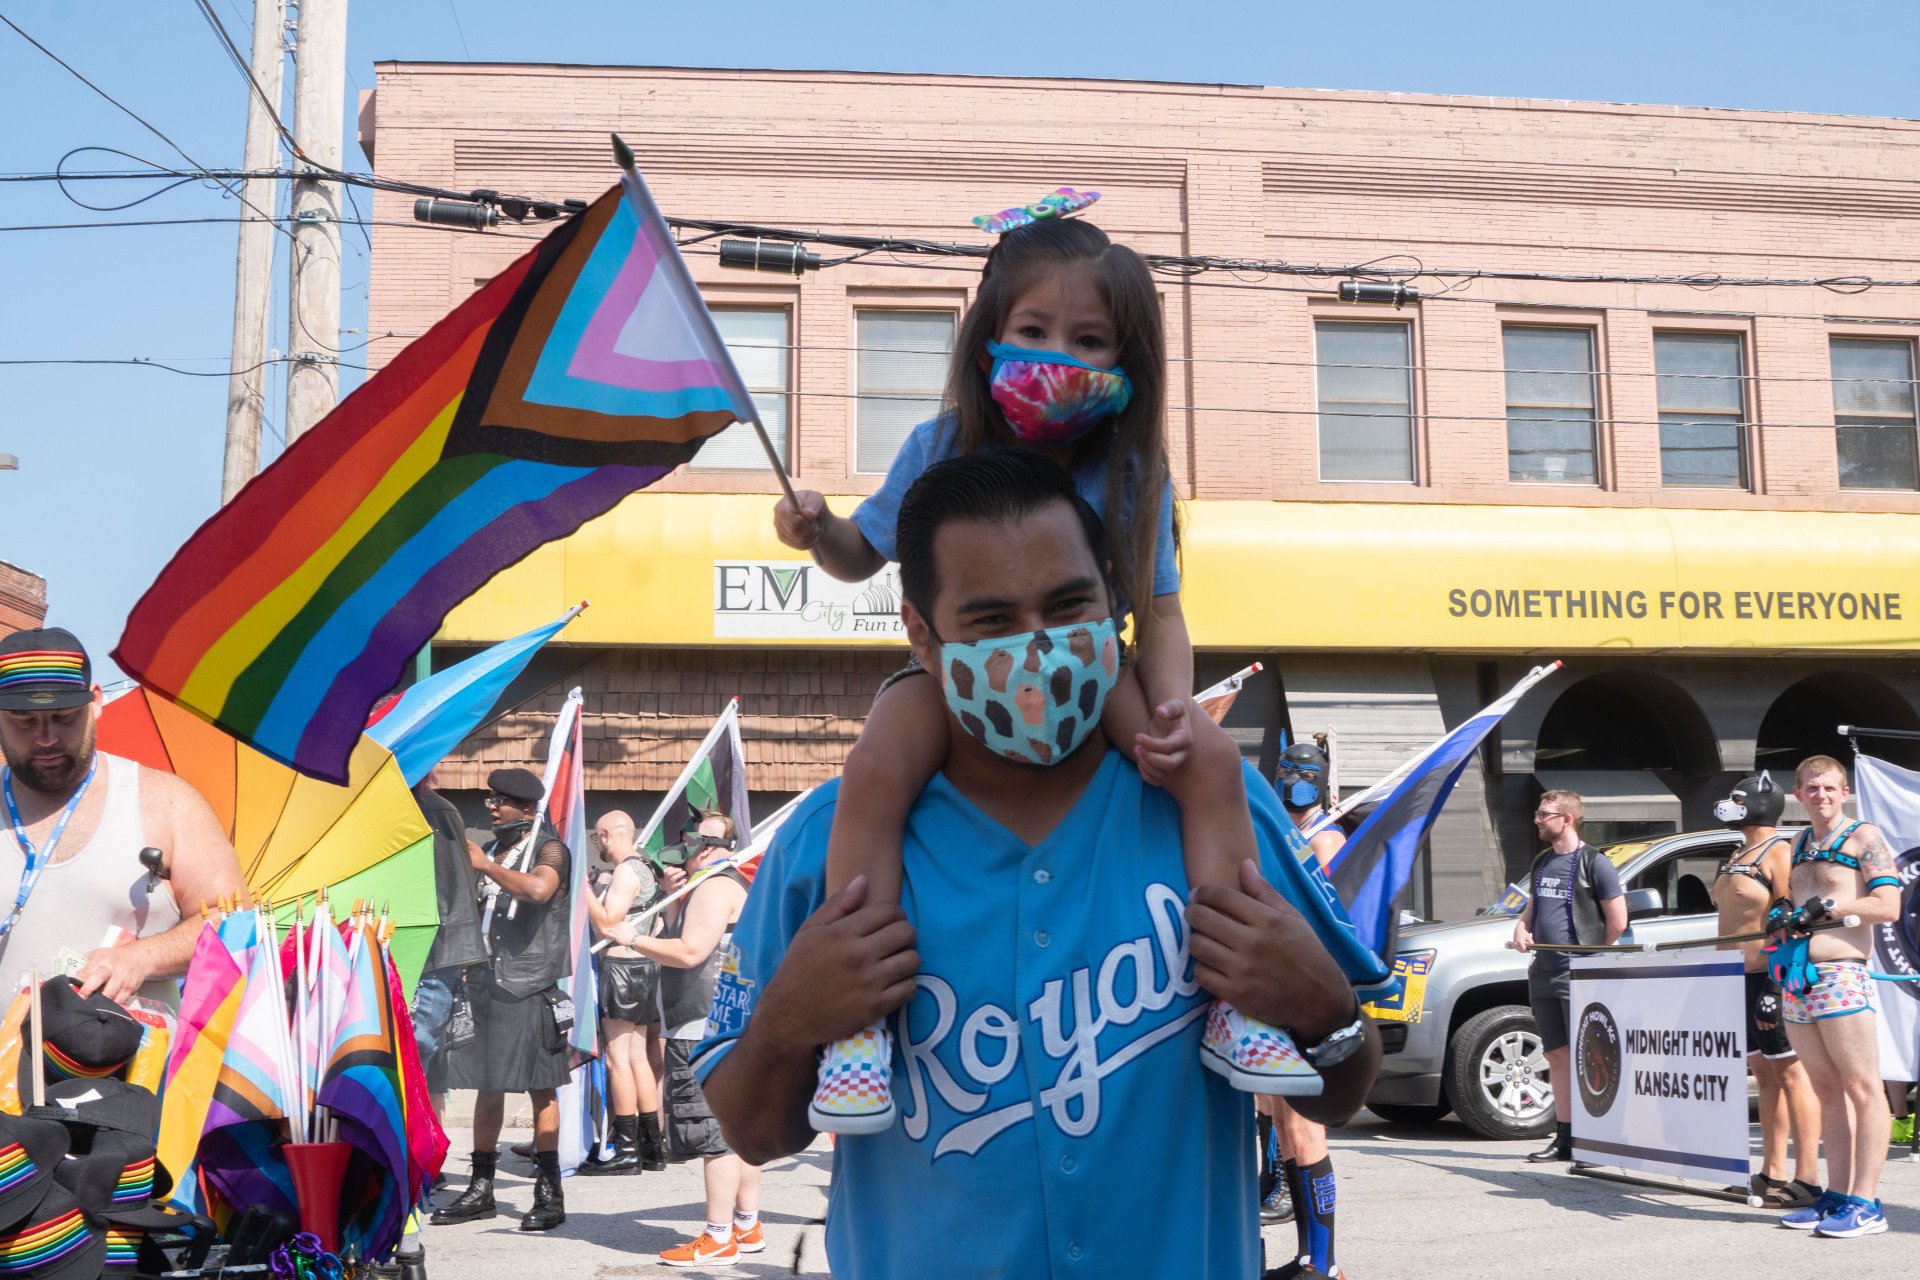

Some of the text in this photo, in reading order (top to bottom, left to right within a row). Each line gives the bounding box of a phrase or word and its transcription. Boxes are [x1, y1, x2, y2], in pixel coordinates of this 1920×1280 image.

[714, 565, 814, 612] EM
[1448, 588, 1902, 621] SOMETHING FOR EVERYONE
[801, 600, 850, 632] City
[853, 618, 887, 632] Fun
[711, 1002, 733, 1024] ME
[900, 882, 1204, 1142] Royal
[1625, 1029, 1742, 1059] MIDNIGHT HOWL
[1634, 1070, 1690, 1100] KANSAS
[1693, 1073, 1729, 1102] CITY
